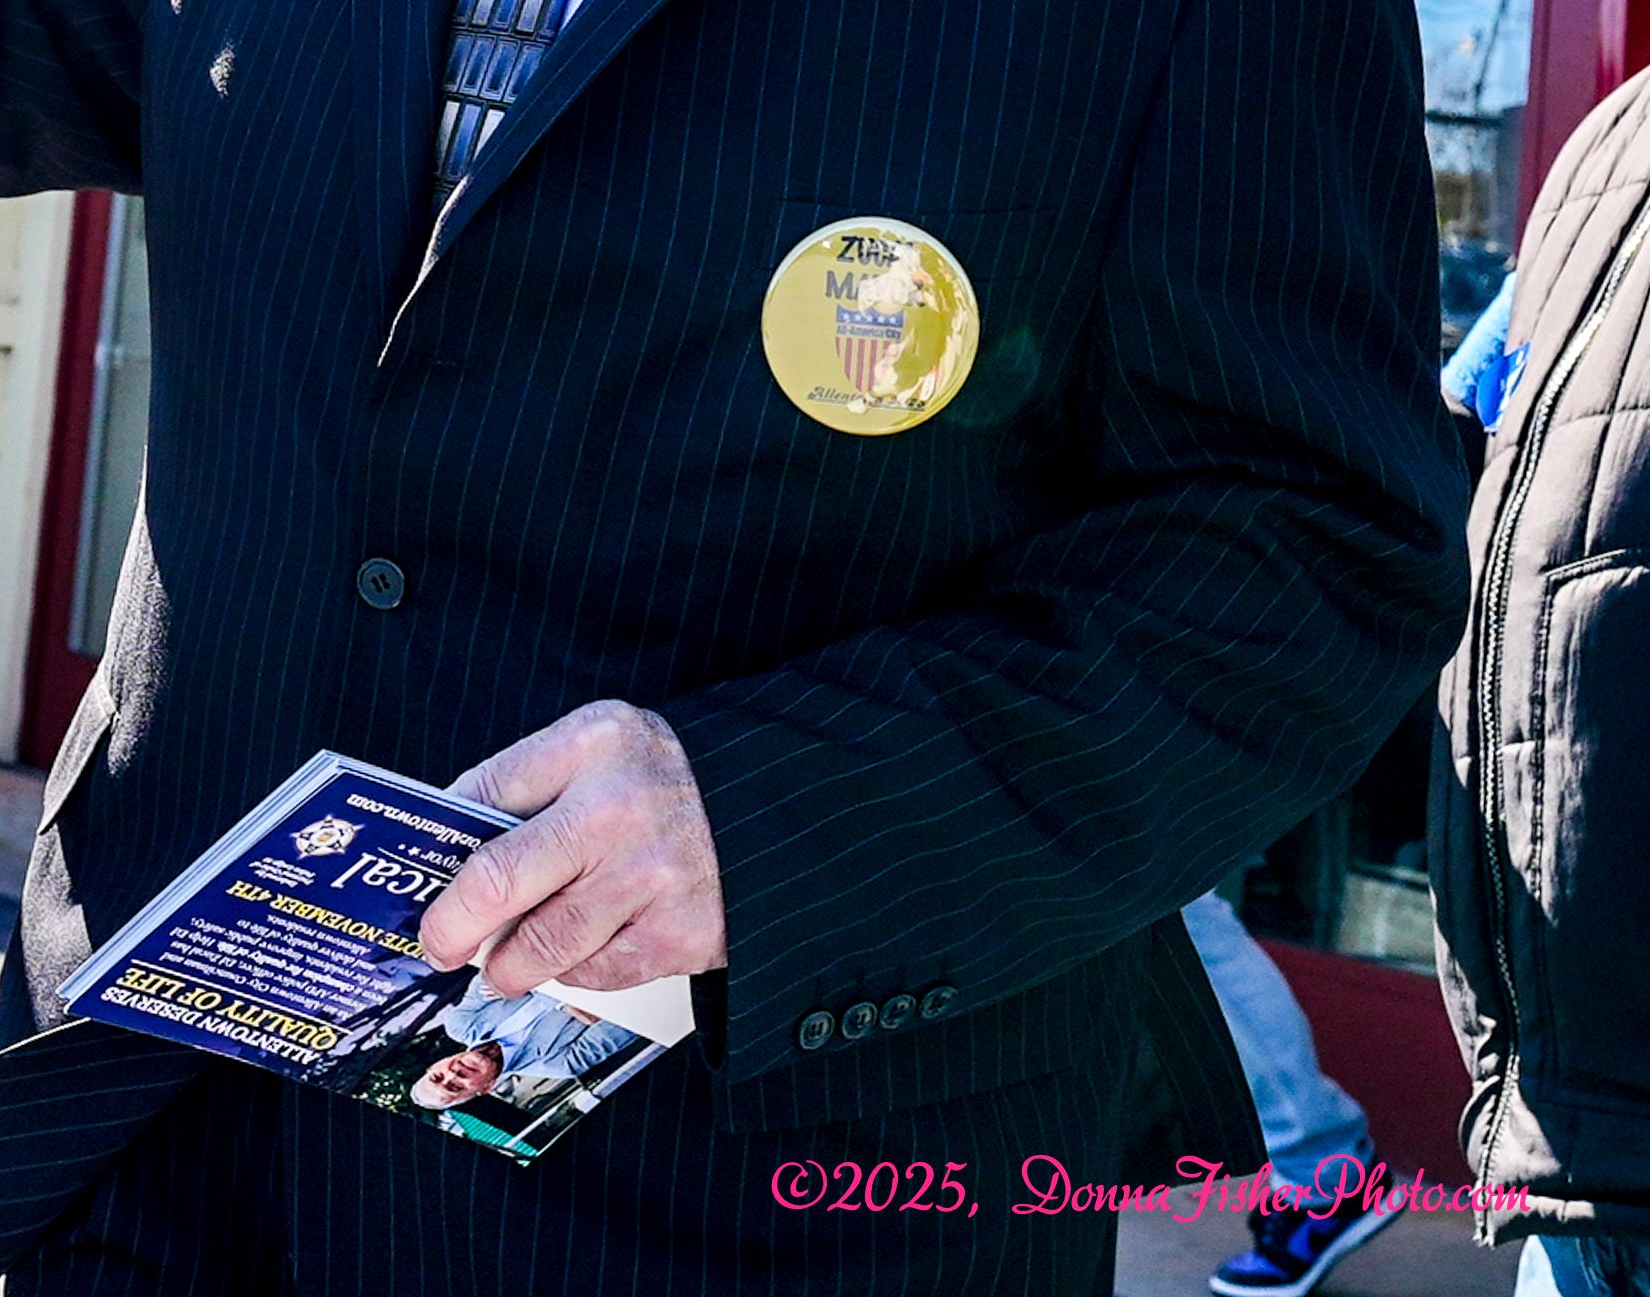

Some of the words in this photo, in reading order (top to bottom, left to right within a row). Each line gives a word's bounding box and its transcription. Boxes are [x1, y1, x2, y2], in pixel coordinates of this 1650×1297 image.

[346, 793, 480, 851] orAllentown.com
[330, 852, 448, 901] ucal
[225, 880, 271, 901] 4TH
[269, 893, 384, 942] NOVEMBER
[188, 931, 215, 946] Help
[224, 930, 261, 945] public
[249, 923, 269, 936] life
[258, 941, 303, 962] improve
[280, 933, 318, 950] quality
[316, 931, 371, 955] Allentown
[158, 951, 184, 962] and
[247, 950, 287, 968] quality
[317, 947, 355, 965] deliver
[350, 958, 376, 971] and
[115, 967, 185, 999] LIFE
[246, 977, 269, 992] City
[273, 974, 309, 989] police
[302, 968, 355, 993] champion
[100, 986, 202, 1025] DESERVES
[176, 987, 221, 1010] OF
[269, 986, 324, 1010] Allentown
[214, 999, 347, 1050] QUALITY
[195, 1015, 320, 1064] ALLENTOWN
